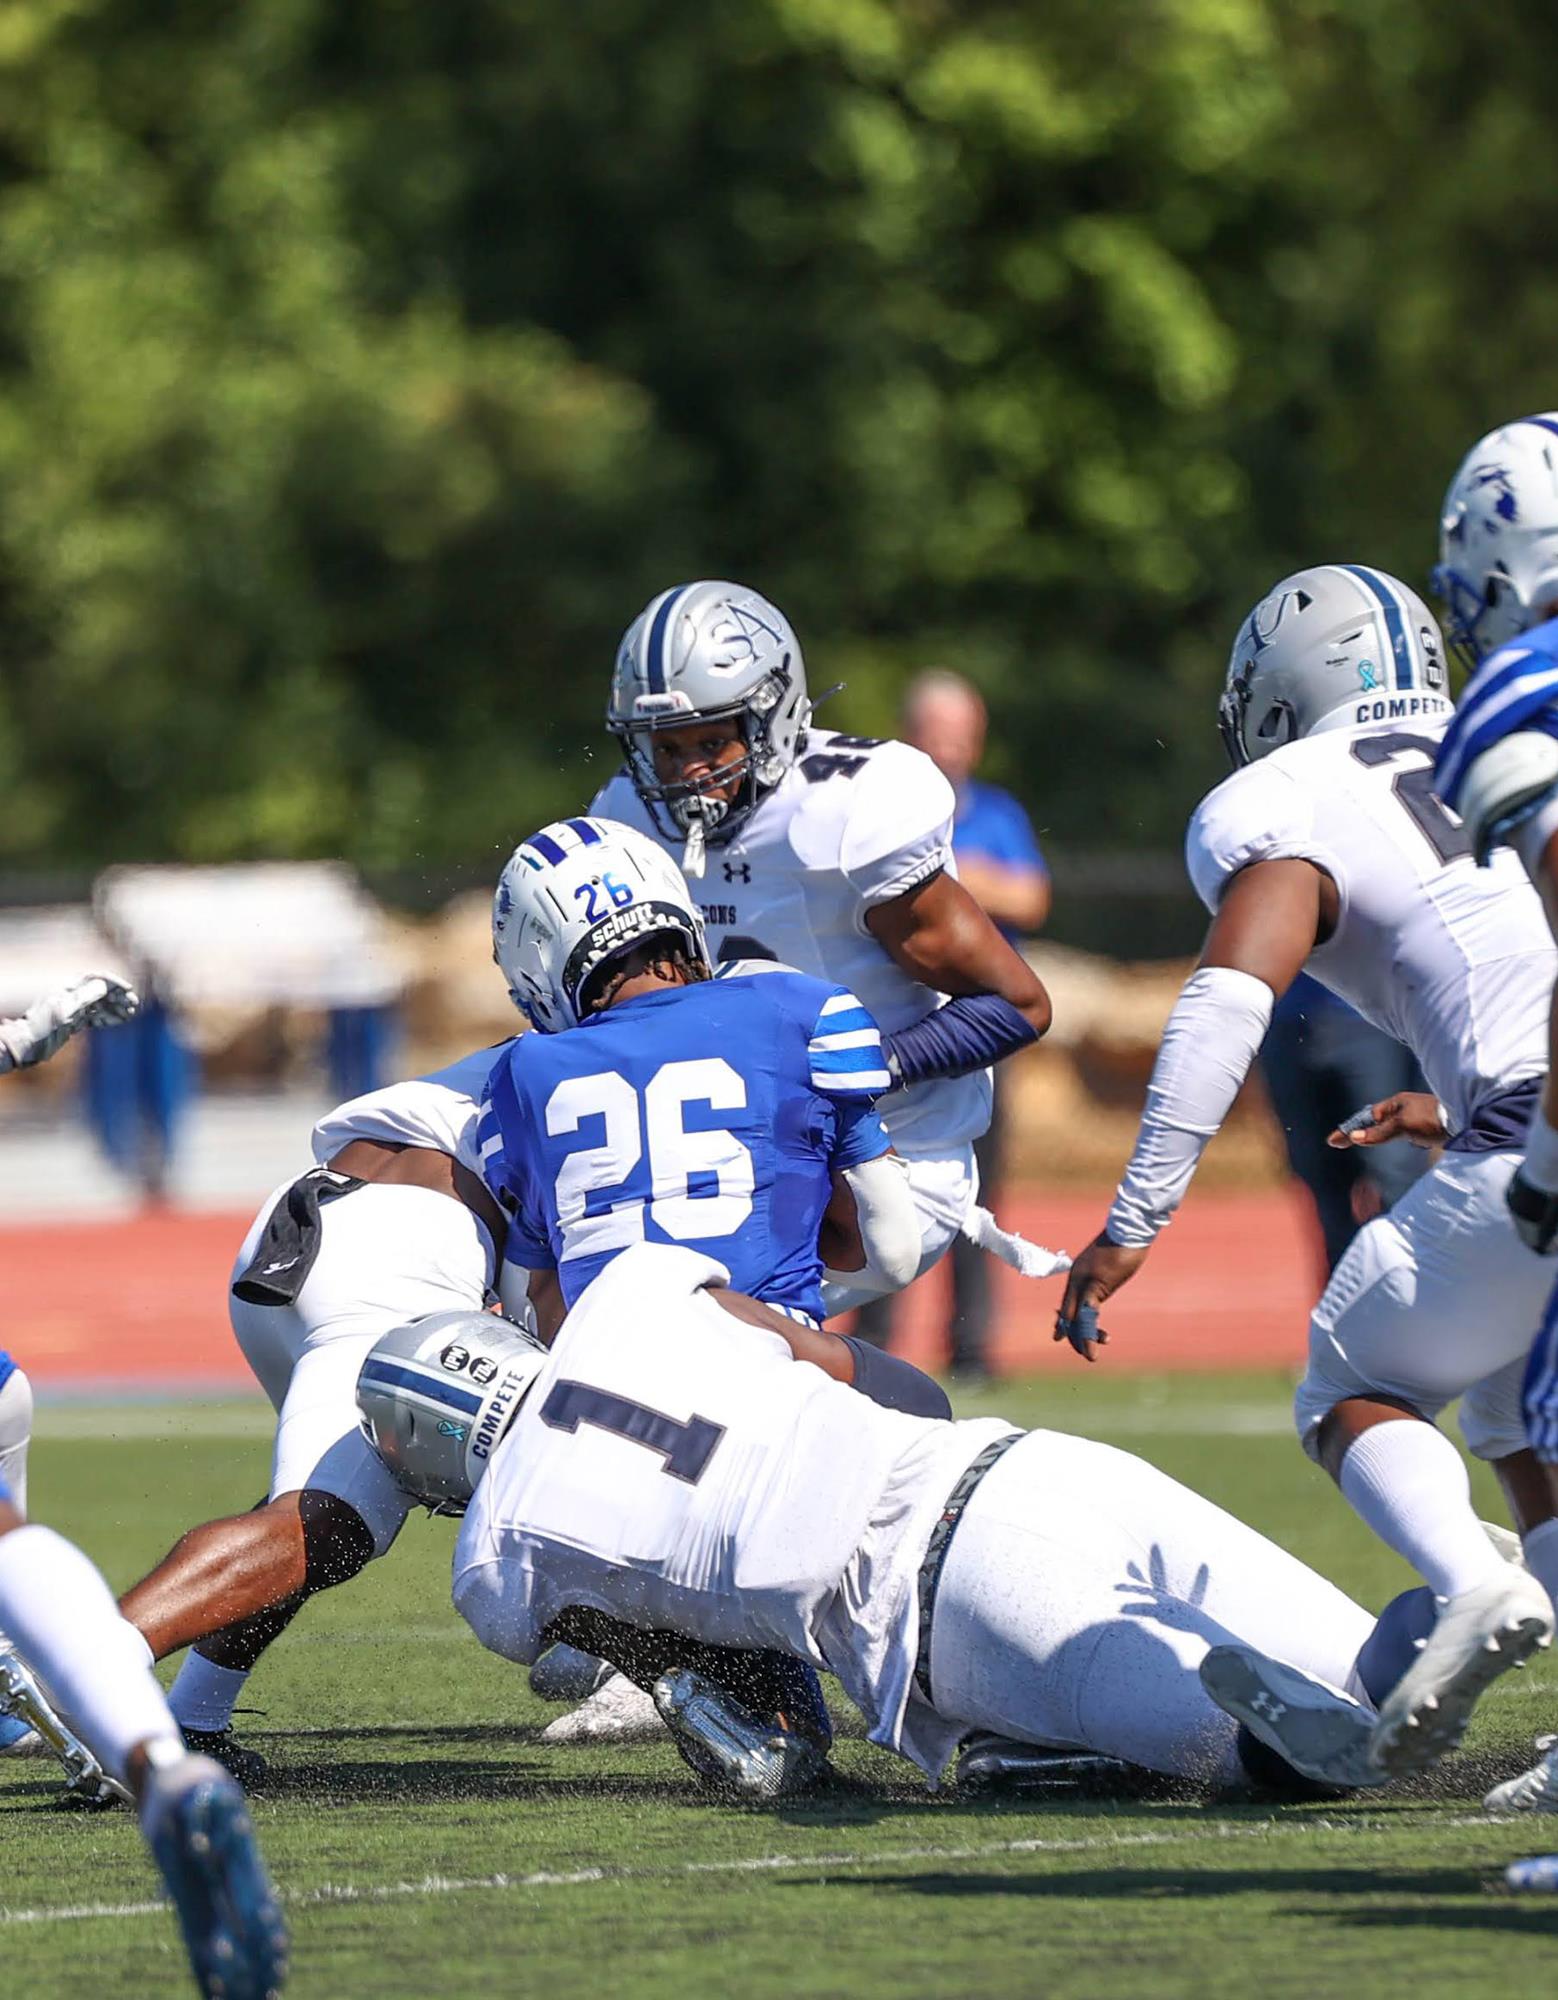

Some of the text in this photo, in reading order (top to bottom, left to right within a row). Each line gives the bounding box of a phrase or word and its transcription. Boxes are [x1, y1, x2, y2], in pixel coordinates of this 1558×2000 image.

[574, 872, 634, 925] 26
[700, 904, 737, 925] CONS
[544, 1057, 755, 1262] 26
[472, 1369, 525, 1460] COMPETE
[538, 1378, 727, 1486] 1
